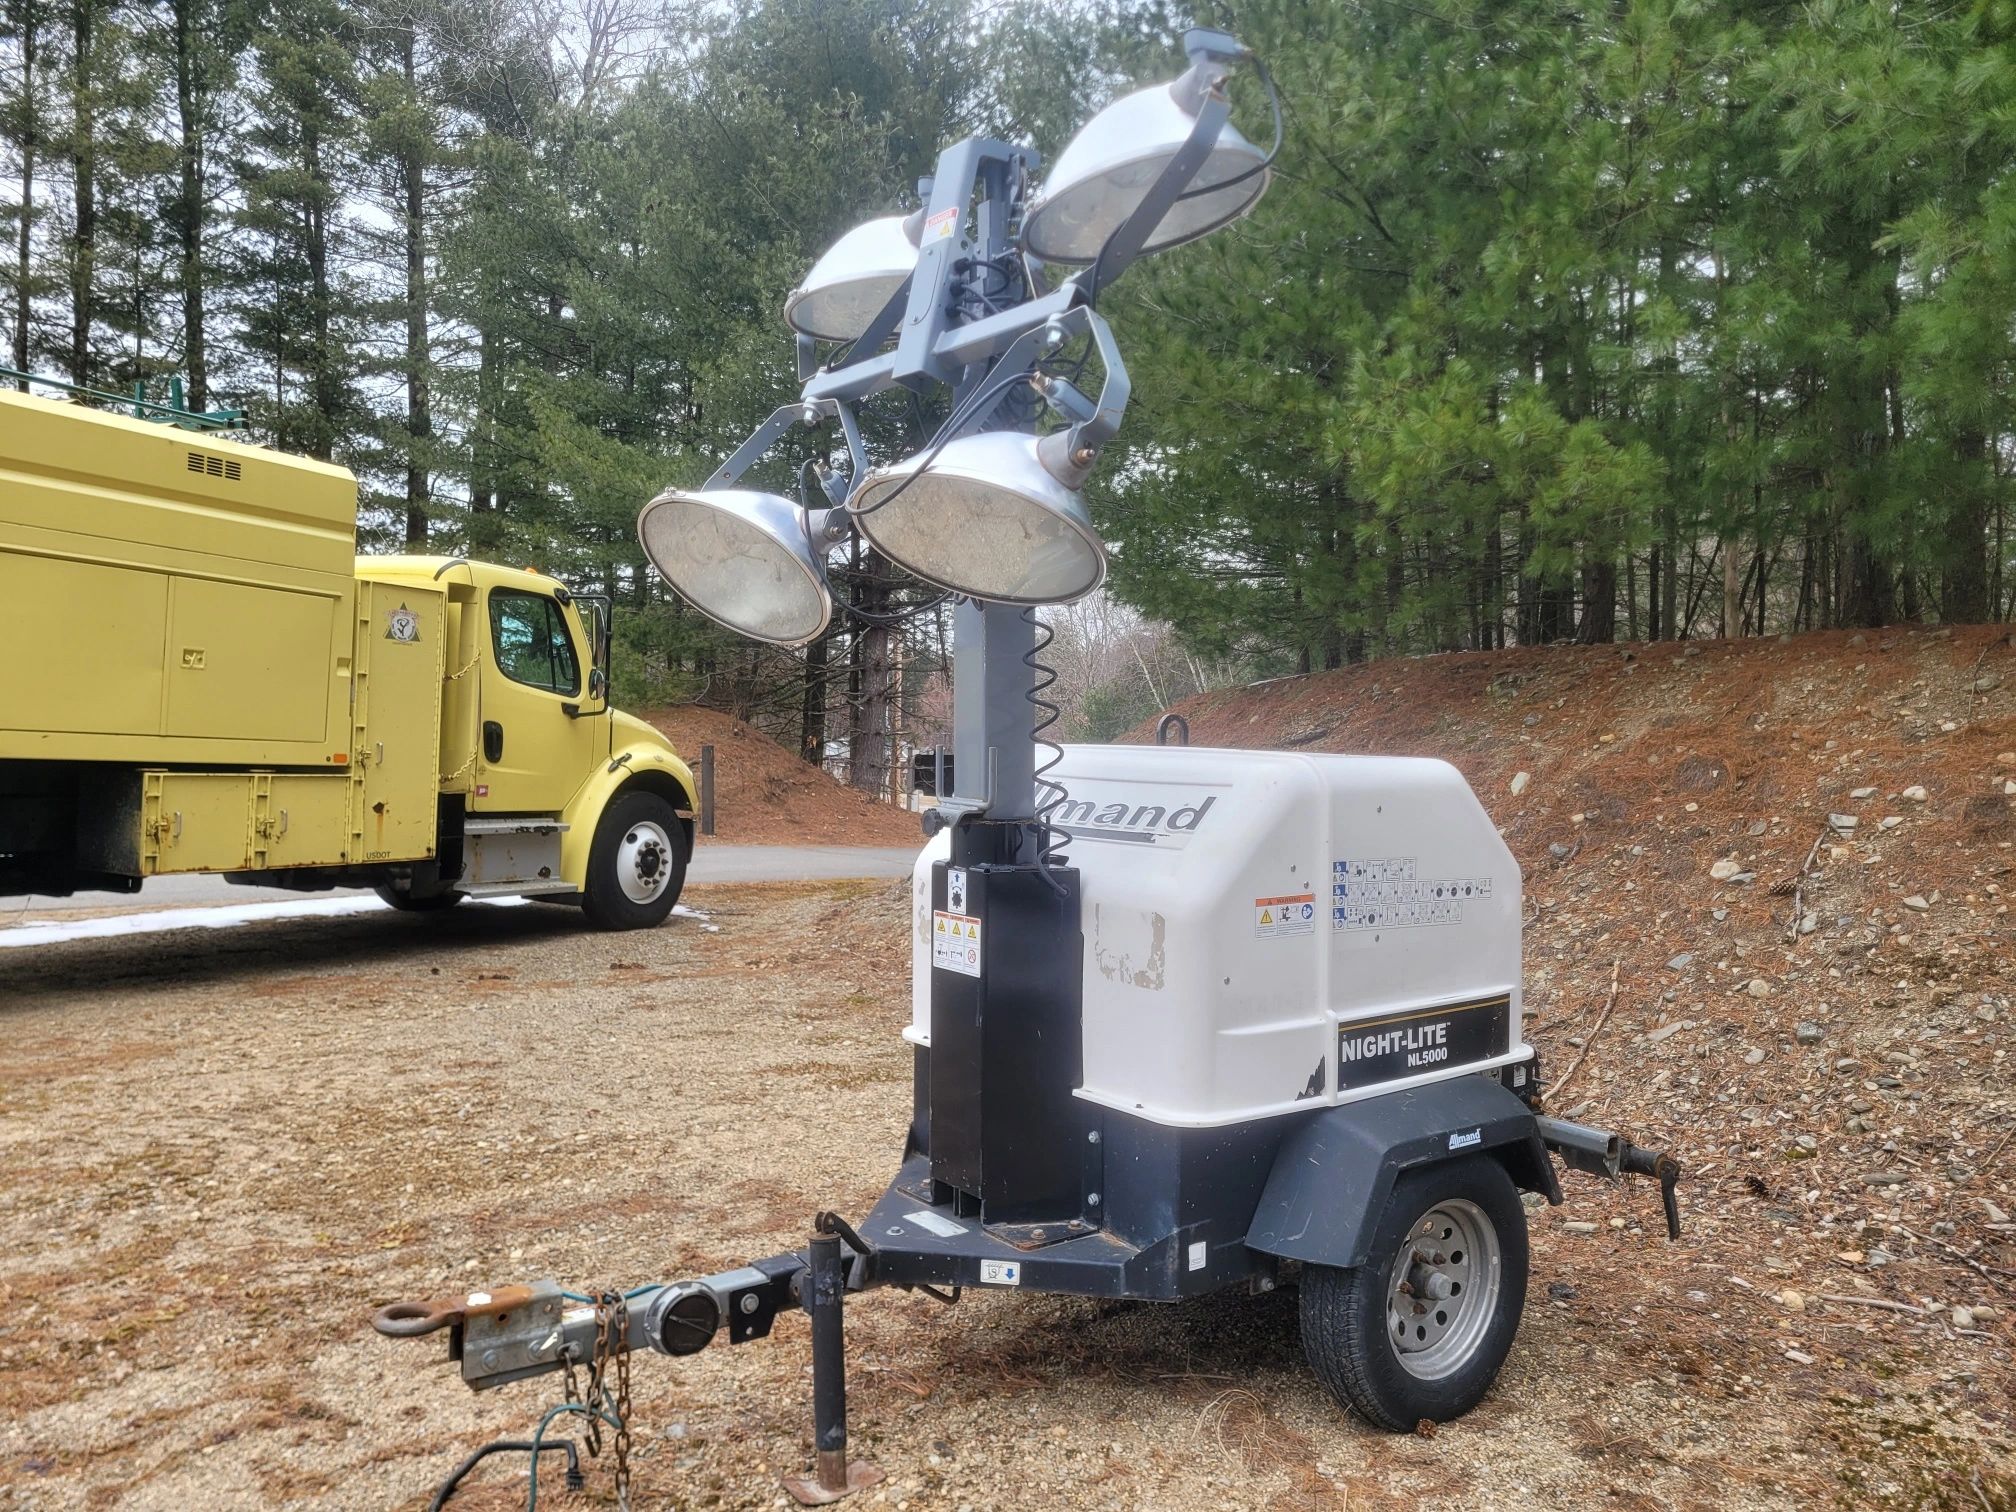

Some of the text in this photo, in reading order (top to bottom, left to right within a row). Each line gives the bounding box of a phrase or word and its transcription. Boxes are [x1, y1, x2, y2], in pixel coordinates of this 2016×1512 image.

[366, 851, 391, 859] USDOT
[1341, 1022, 1447, 1063] NIGHT-LITE
[1407, 1047, 1448, 1067] NL5000
[1449, 1128, 1481, 1147] Allmand
